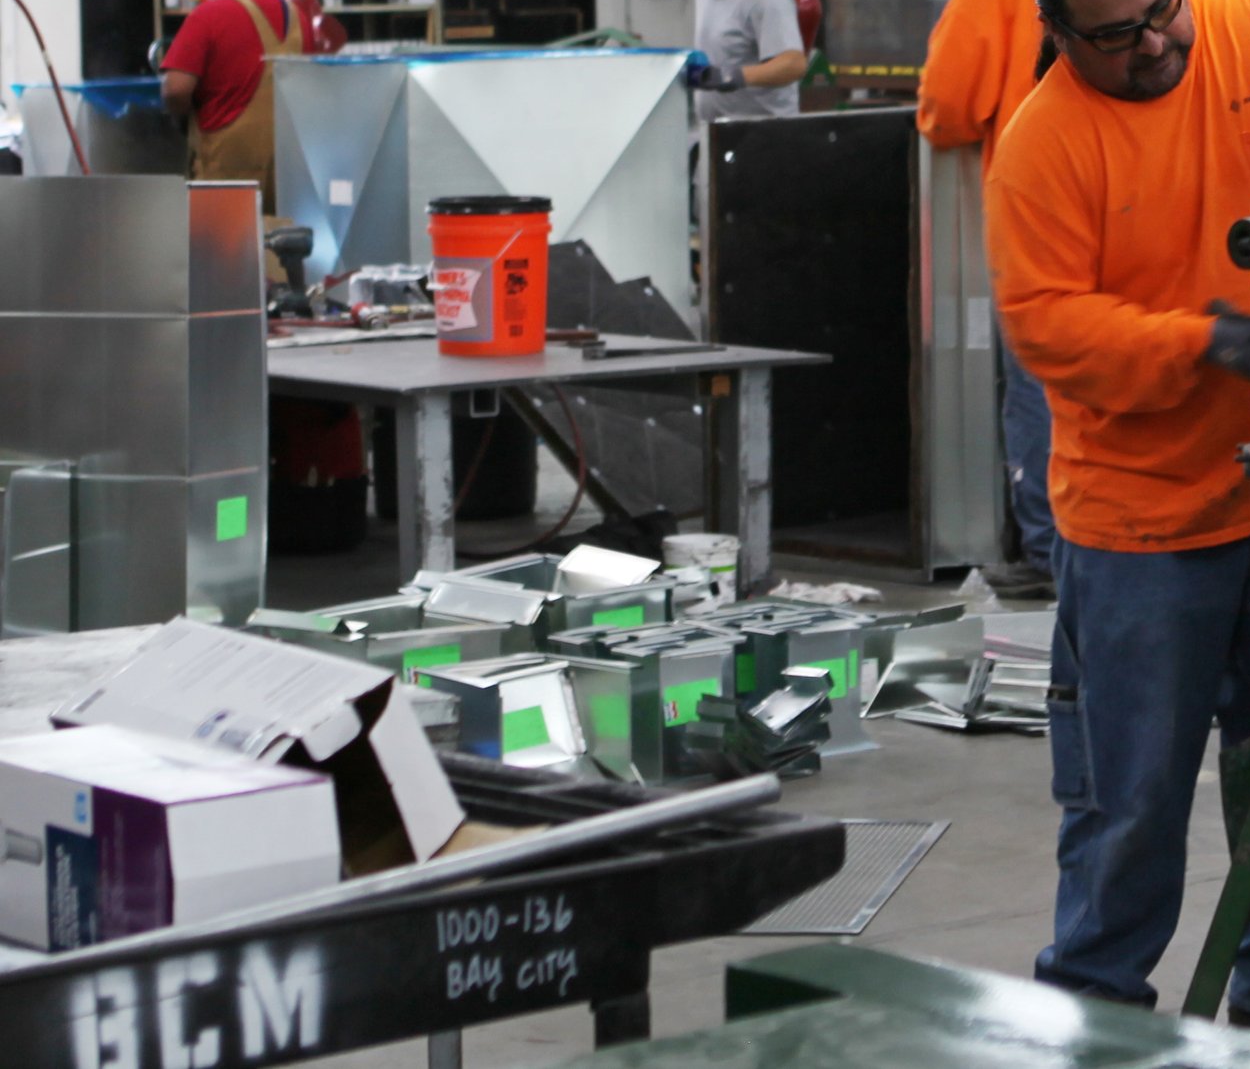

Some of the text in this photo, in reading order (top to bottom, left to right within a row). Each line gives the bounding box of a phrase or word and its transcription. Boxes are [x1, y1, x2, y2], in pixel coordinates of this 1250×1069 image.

[436, 894, 574, 953] 1000-136
[70, 939, 324, 1069] BCM
[446, 948, 578, 1003] BAY CITY
